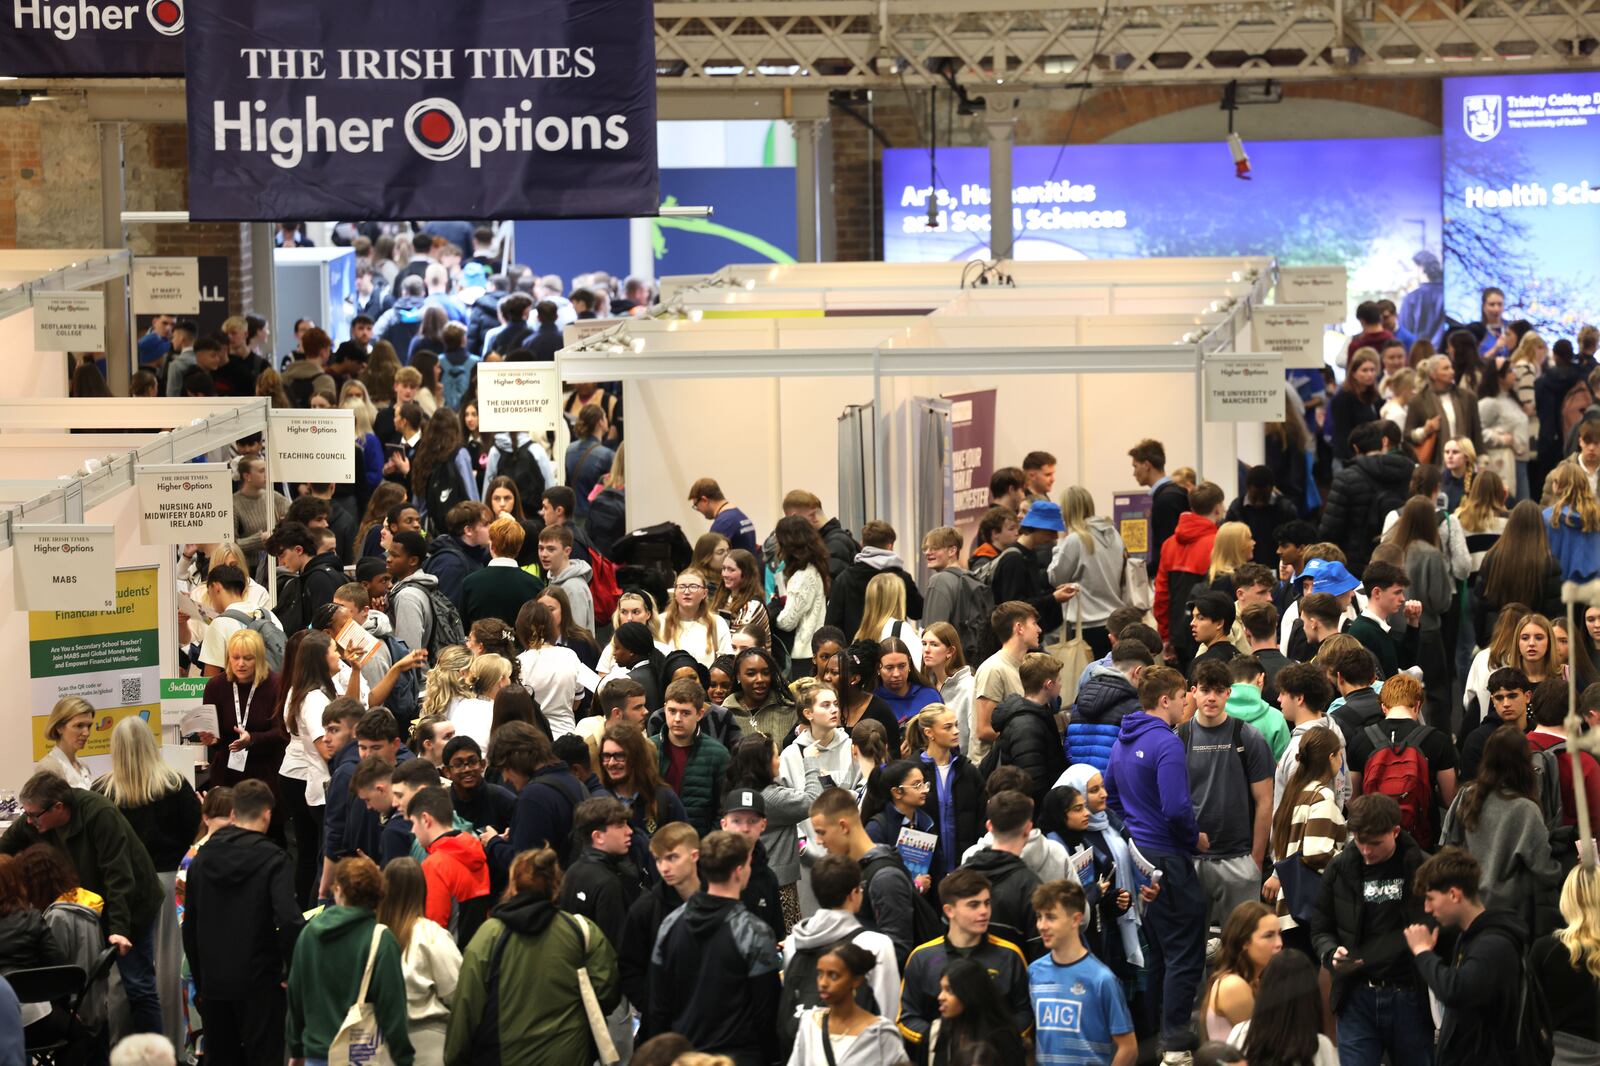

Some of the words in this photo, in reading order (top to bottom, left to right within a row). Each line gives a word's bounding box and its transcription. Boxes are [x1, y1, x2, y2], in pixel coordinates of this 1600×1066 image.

[14, 0, 139, 41] Higher
[240, 48, 327, 80] THE
[337, 48, 456, 80] IRISH
[464, 46, 596, 80] TIMES
[1506, 94, 1547, 109] Trinity
[1547, 92, 1592, 108] College
[213, 95, 394, 169] Higher
[403, 97, 630, 169] Options
[900, 185, 959, 211] Ars,
[961, 179, 1097, 206] Huanities
[1464, 182, 1548, 209] Health
[951, 207, 1022, 232] Socl
[1025, 206, 1128, 231] Sciences
[48, 305, 66, 314] Higher
[40, 323, 77, 331] SCOTLAND'S
[78, 323, 98, 331] RURAL
[1220, 368, 1242, 377] Higher
[493, 378, 514, 387] Higher
[514, 377, 541, 387] Options
[287, 425, 309, 435] Higher
[309, 425, 338, 435] Options
[278, 452, 315, 460] TEACHING
[315, 452, 347, 460] COUNCIL
[157, 483, 182, 493] Higher
[182, 481, 213, 492] Options
[159, 503, 195, 511] NURSING
[196, 502, 213, 510] AND
[144, 511, 188, 520] MIDWIFERY
[189, 511, 216, 519] BOARD
[218, 510, 228, 518] OF
[170, 519, 203, 528] IRELAND
[33, 544, 60, 554] Higher
[61, 543, 94, 554] Options
[52, 575, 77, 584] MABS
[75, 643, 101, 651] Secondary
[120, 638, 142, 646] Teacher?
[89, 657, 112, 665] Financial
[112, 655, 140, 663] Wellbeing.
[167, 681, 206, 697] Instagra
[1042, 1005, 1075, 1025] AIG
